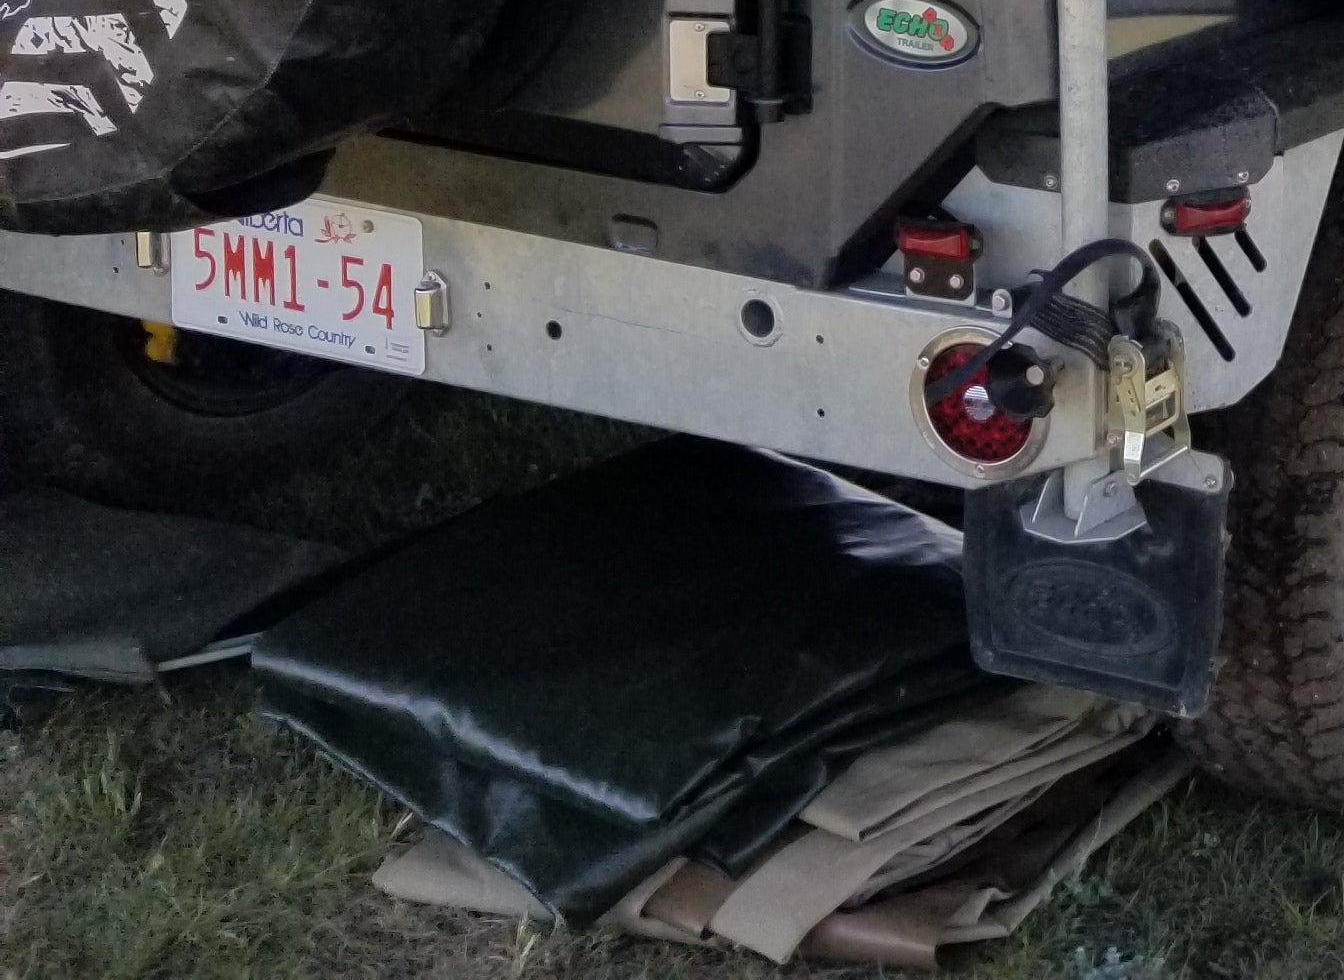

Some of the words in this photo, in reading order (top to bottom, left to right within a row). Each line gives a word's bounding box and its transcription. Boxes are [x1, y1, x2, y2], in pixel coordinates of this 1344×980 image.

[877, 7, 950, 42] ECHO
[897, 38, 934, 52] TRAILER
[235, 211, 304, 237] lberta
[194, 226, 395, 330] 5MM1-54
[238, 310, 269, 330] Wild
[273, 317, 304, 337] Rose
[307, 324, 356, 349] Country
